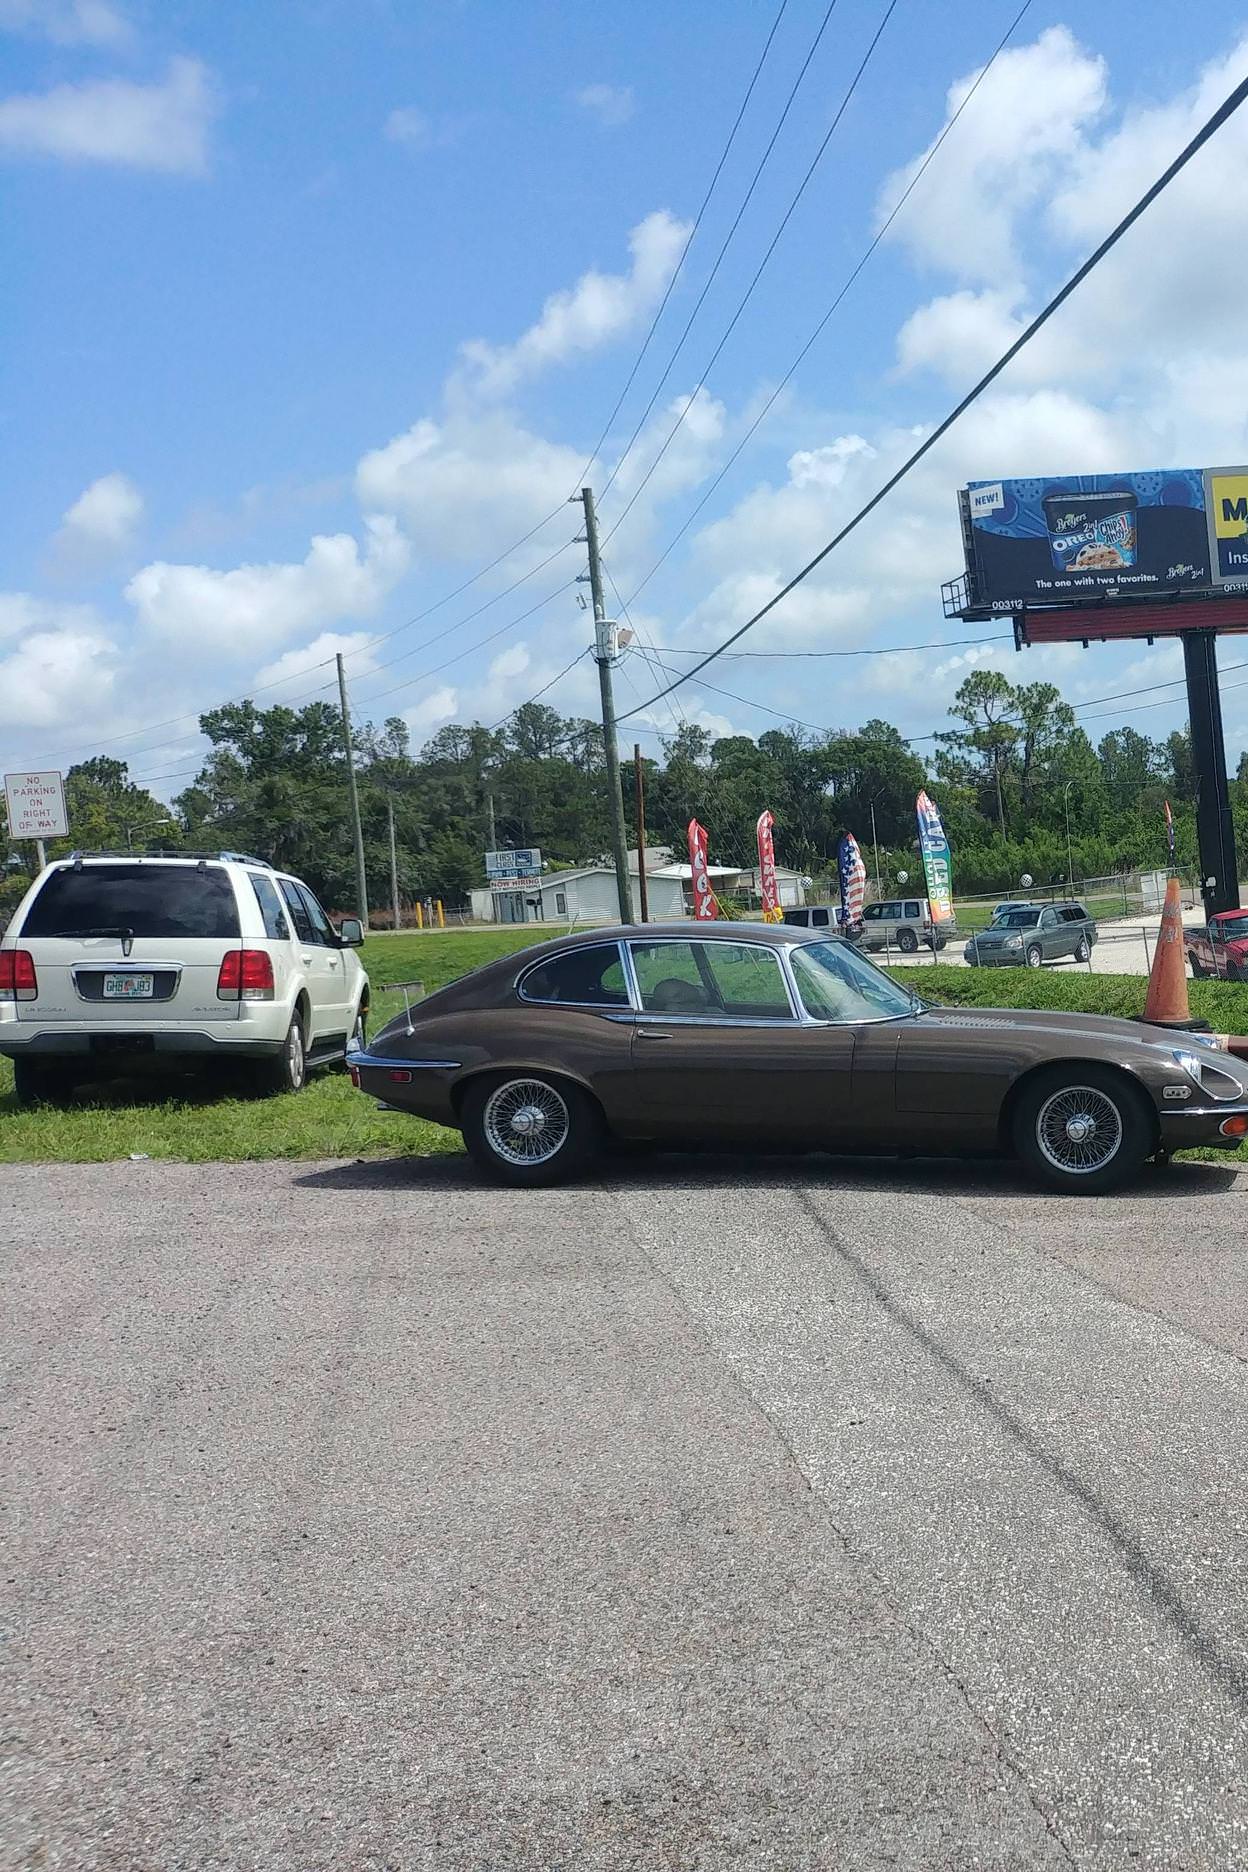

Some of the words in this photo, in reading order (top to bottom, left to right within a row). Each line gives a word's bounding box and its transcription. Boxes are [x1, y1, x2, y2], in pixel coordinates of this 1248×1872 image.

[975, 492, 999, 506] NEW!
[1053, 532, 1095, 552] OREO
[1036, 580, 1052, 588] The
[1055, 580, 1071, 588] one
[1074, 577, 1094, 586] with
[1097, 576, 1115, 584] two
[1117, 573, 1159, 584] favorites.
[26, 777, 40, 785] NO
[13, 786, 56, 796] PARKING
[29, 799, 43, 807] ON
[23, 809, 51, 818] RIGHT
[19, 821, 33, 829] OF
[38, 820, 57, 828] WAY
[932, 858, 951, 912] USED
